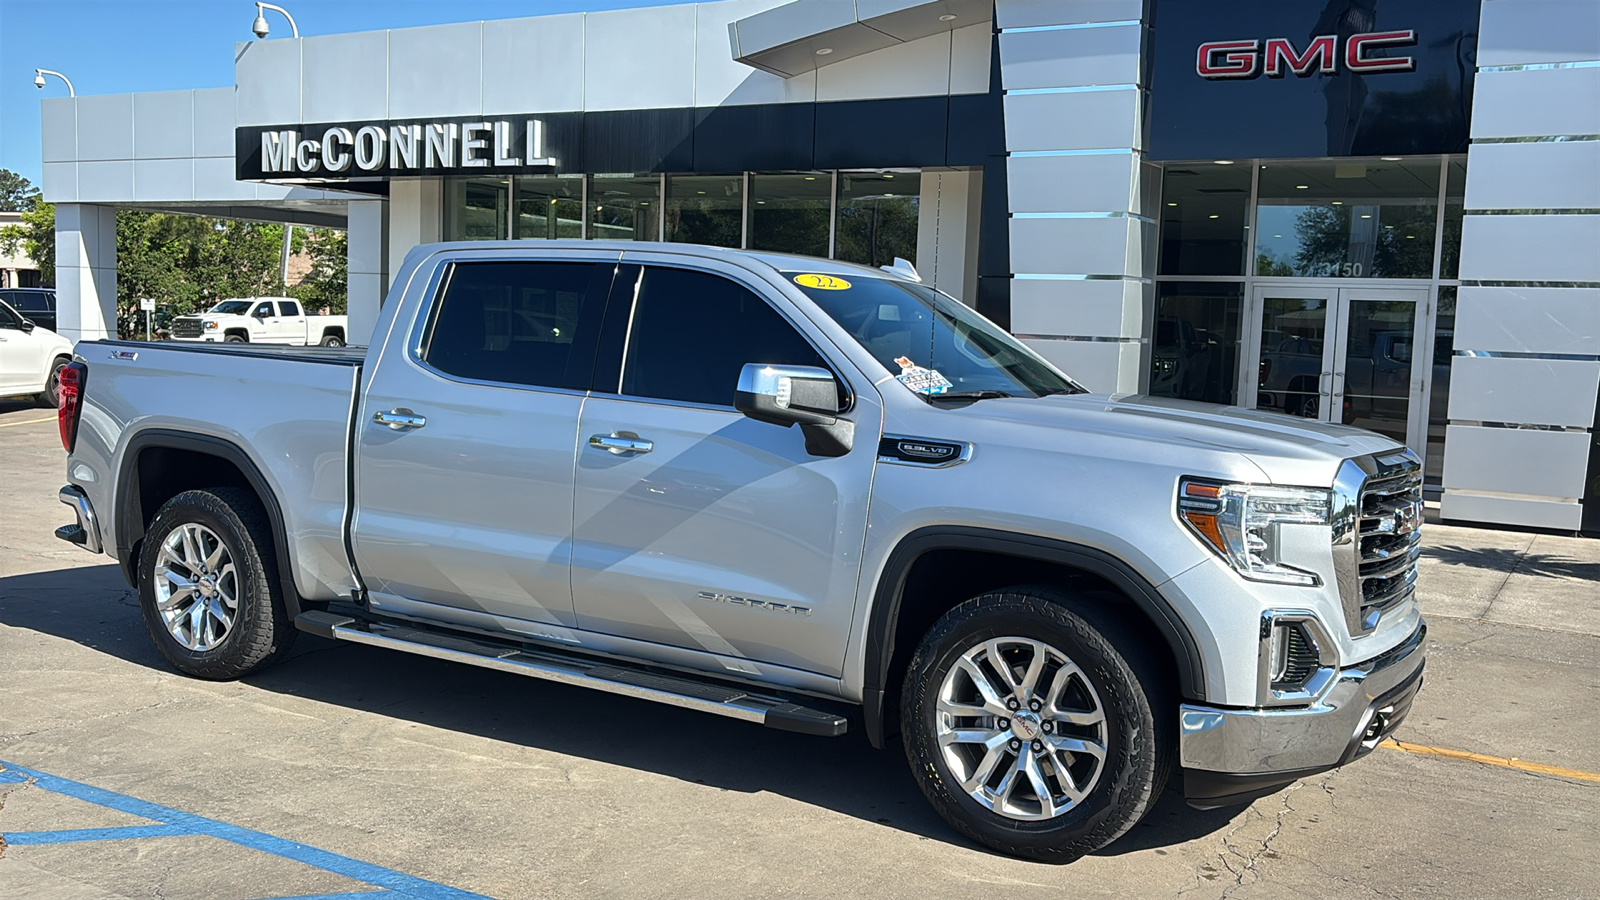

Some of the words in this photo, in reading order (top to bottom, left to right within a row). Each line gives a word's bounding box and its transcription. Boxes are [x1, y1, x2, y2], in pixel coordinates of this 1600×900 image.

[1196, 29, 1415, 78] GMC
[260, 119, 556, 173] McCONNELL
[1321, 262, 1363, 277] 3150
[811, 276, 837, 287] 22
[698, 591, 812, 616] SIERRA
[1014, 715, 1035, 736] GMC
